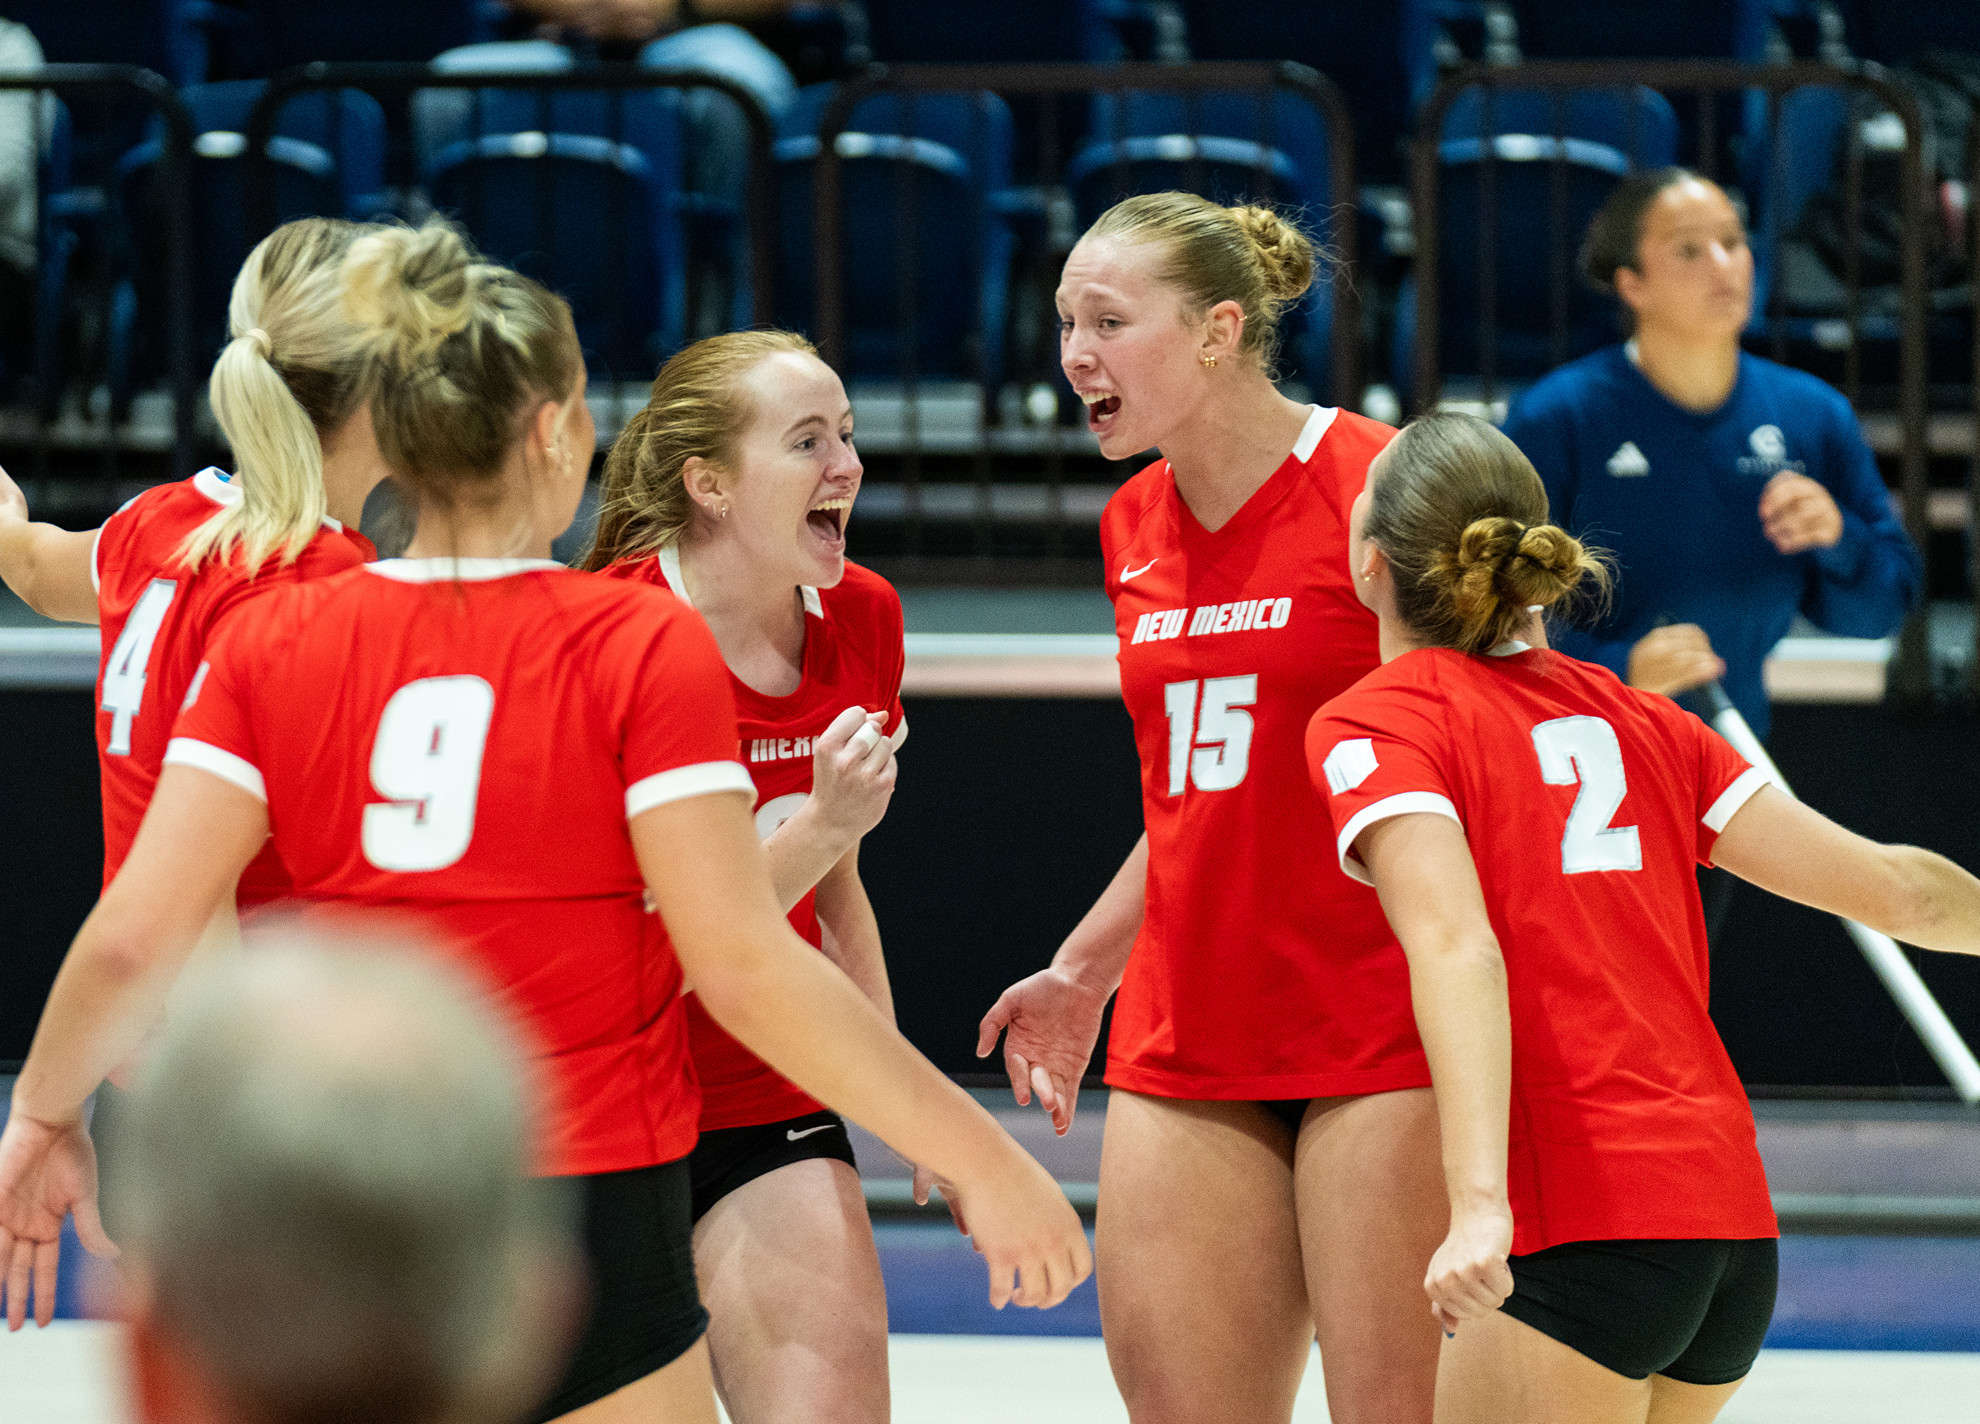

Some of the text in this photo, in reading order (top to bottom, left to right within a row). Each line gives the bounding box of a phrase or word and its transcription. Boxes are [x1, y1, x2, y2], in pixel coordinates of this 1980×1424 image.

[101, 578, 178, 755] 4
[1131, 597, 1293, 645] NEW MEXICO
[361, 674, 495, 872] 9
[750, 735, 821, 763] MEXI
[1164, 673, 1258, 797] 15
[1531, 714, 1643, 874] 2
